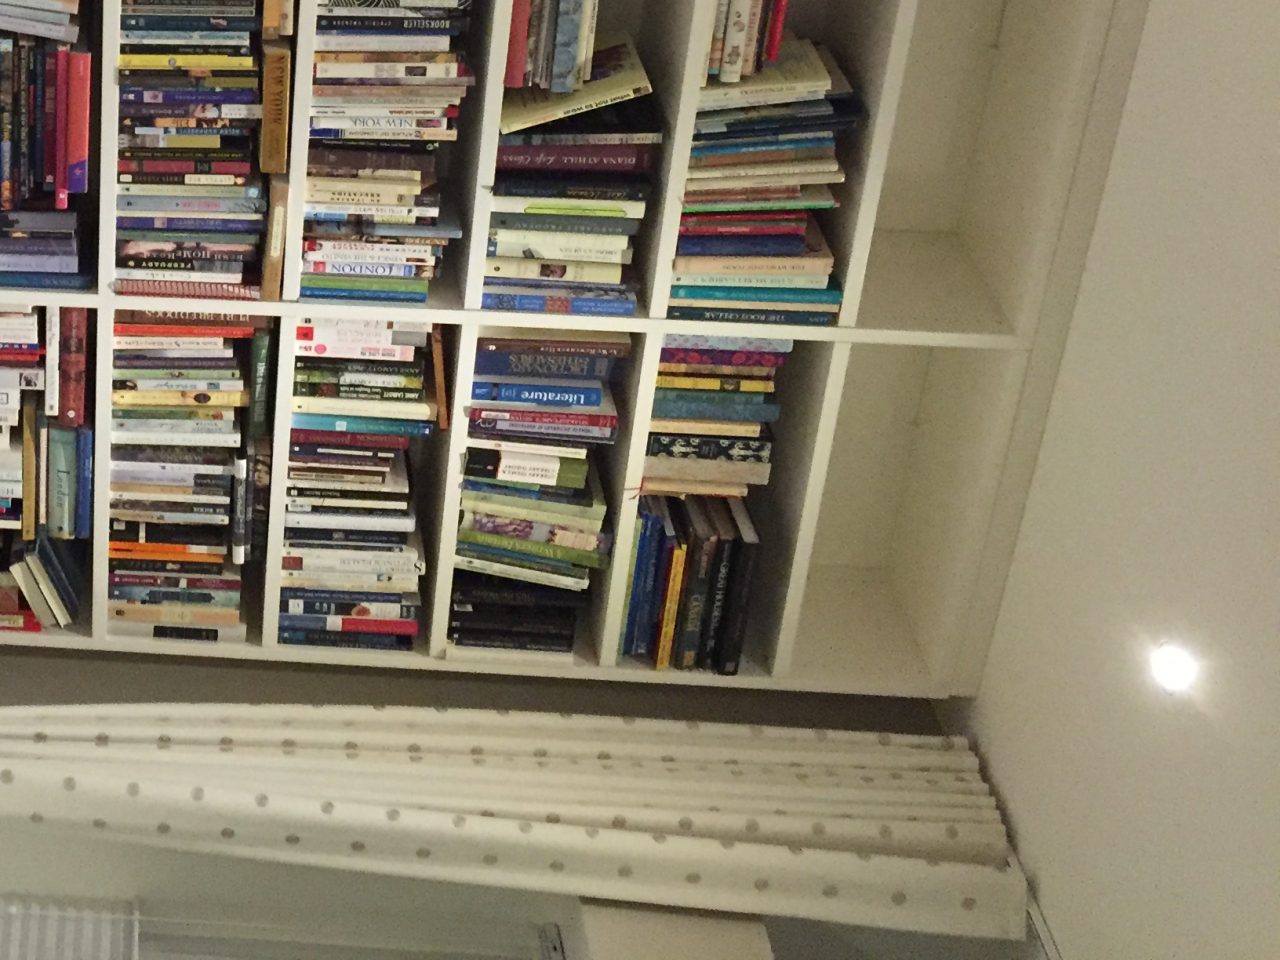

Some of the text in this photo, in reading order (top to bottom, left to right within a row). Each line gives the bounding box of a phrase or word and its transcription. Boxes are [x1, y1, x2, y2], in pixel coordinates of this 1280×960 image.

[403, 19, 450, 29] BOOKSELLER
[593, 98, 609, 107] not
[350, 118, 413, 128] NEW YORK
[561, 156, 636, 165] DIANA ATHILL
[141, 260, 192, 269] FEBRUARY
[331, 263, 395, 276] LONDON
[144, 309, 185, 321] DOGS
[704, 311, 739, 319] CELLAR
[511, 364, 589, 377] DICTIONARY
[383, 390, 419, 399] ANNE LAMOTT
[520, 391, 585, 405] Literature
